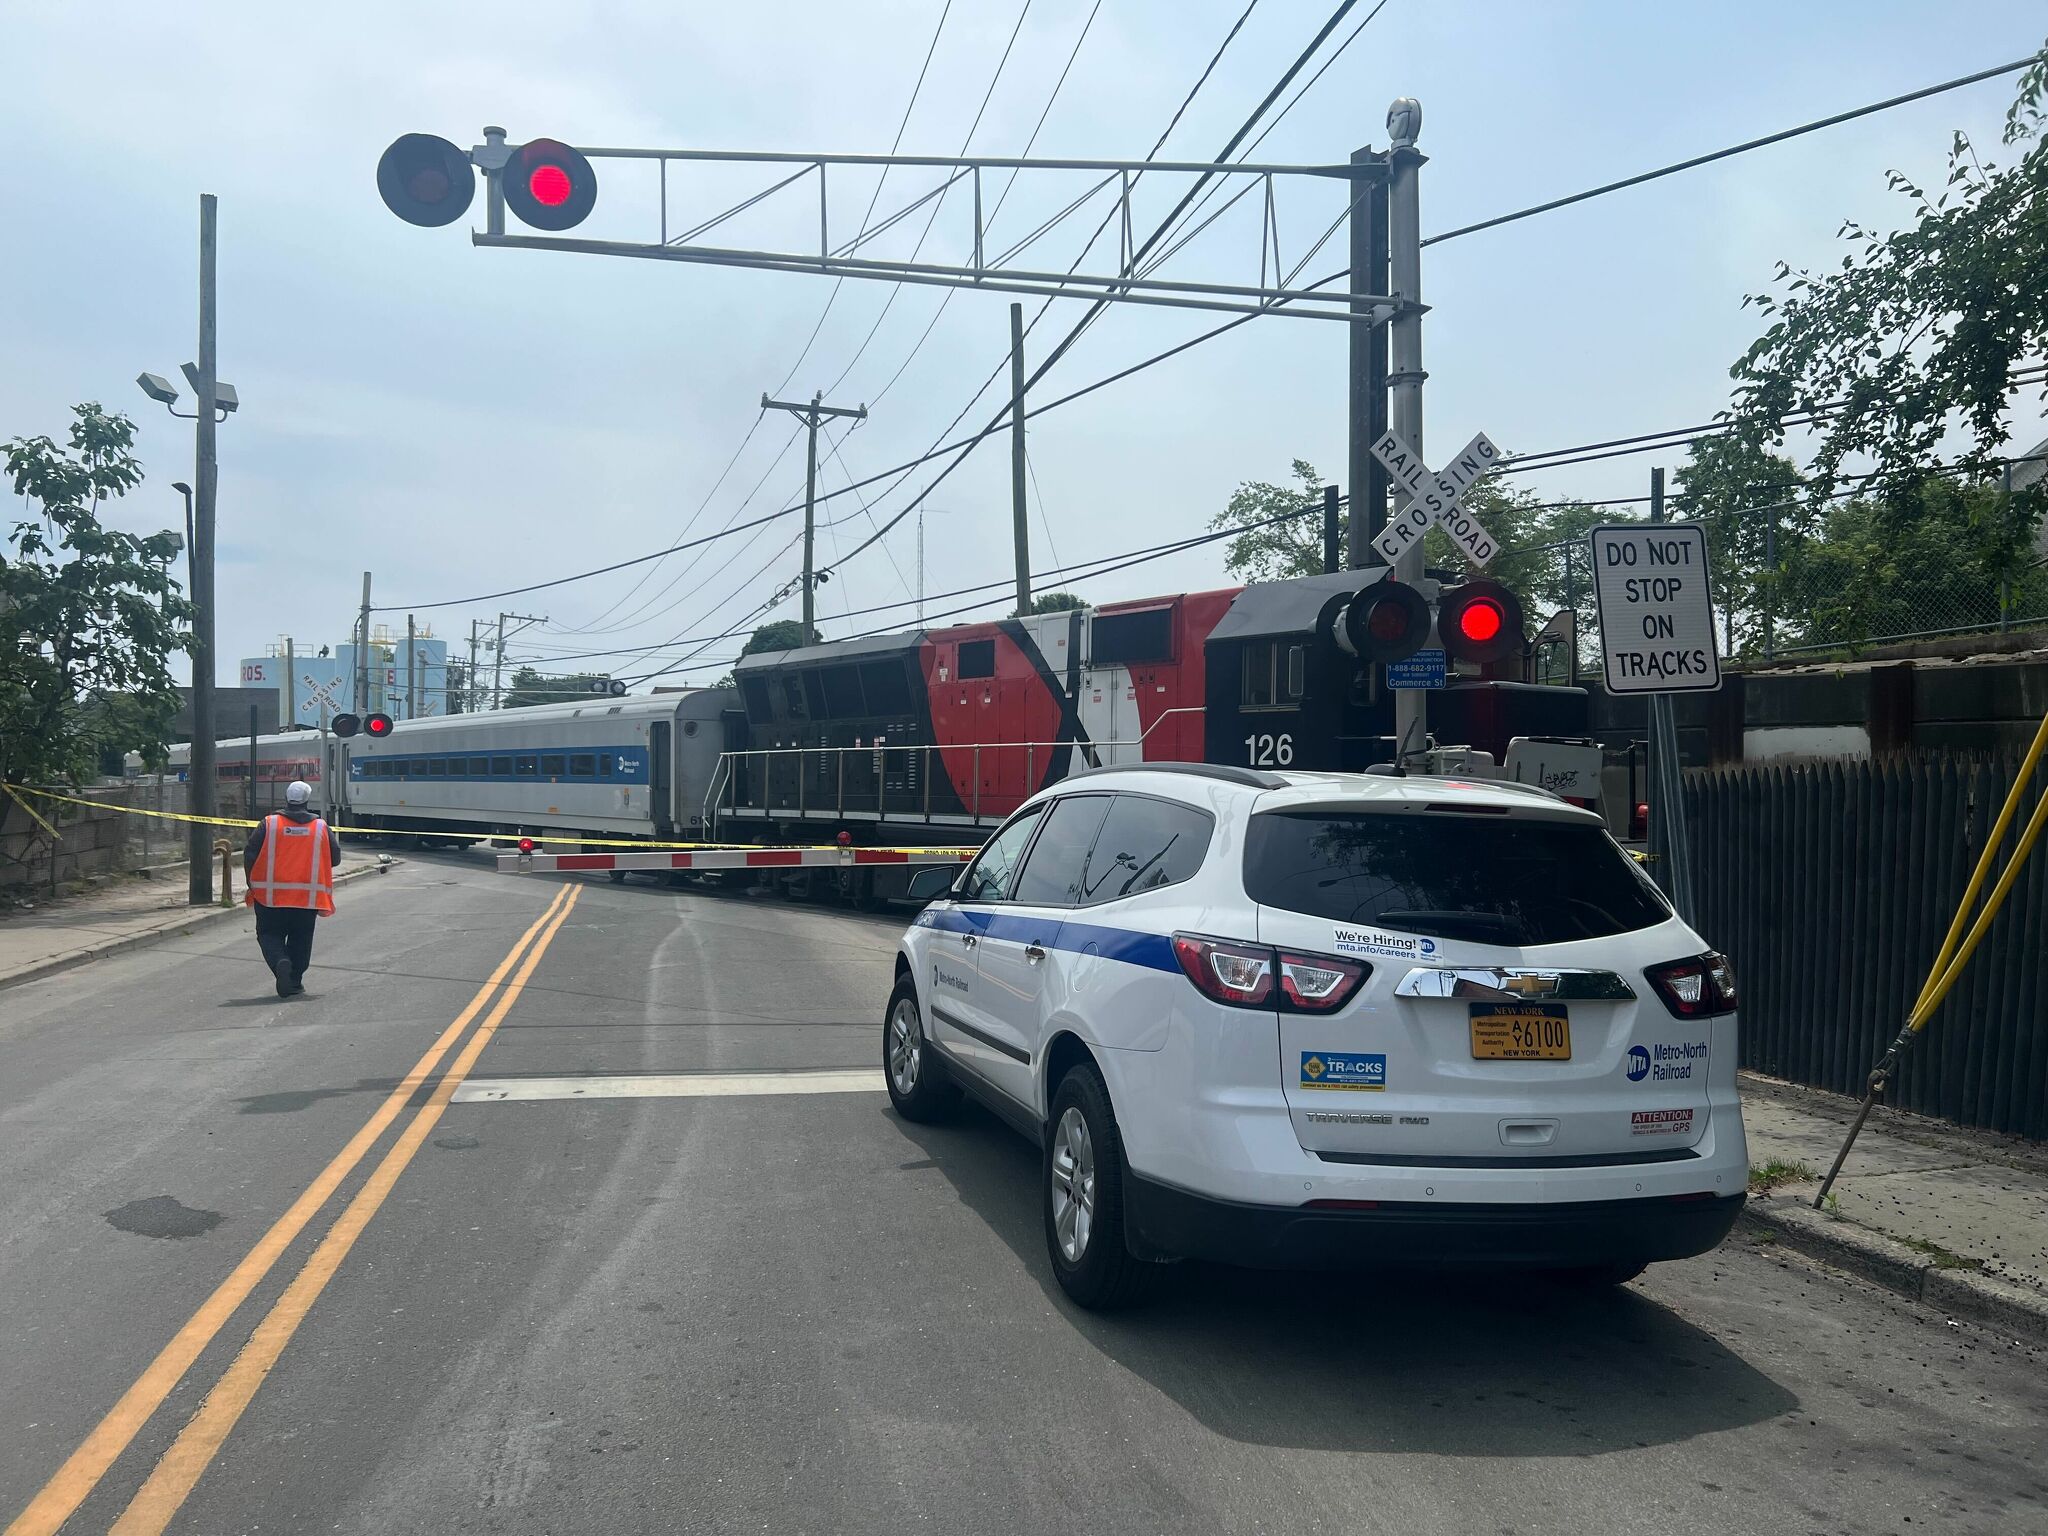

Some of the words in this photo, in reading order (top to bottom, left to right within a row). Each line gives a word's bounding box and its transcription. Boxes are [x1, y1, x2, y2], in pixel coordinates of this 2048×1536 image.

[1378, 437, 1423, 491] RAIL
[1382, 441, 1494, 557] CROSSING
[1443, 507, 1491, 559] ROAD
[1606, 541, 1637, 567] DO
[1649, 541, 1691, 566] NOT
[1625, 577, 1682, 603] STOP
[1642, 614, 1674, 639] ON
[1388, 664, 1444, 672] 1-888-682-9117
[1615, 650, 1707, 677] TRACKS
[303, 675, 319, 692] RAIL
[1389, 679, 1431, 687] Commerce
[1434, 679, 1443, 687] St
[302, 676, 343, 711] CROSSING
[324, 696, 341, 713] ROAD
[1244, 733, 1293, 766] 126
[1335, 930, 1371, 943] We're
[1373, 934, 1417, 950] Hiring!
[1337, 943, 1416, 959] mta.info/careers
[1494, 1006, 1516, 1015] NEW
[1520, 1007, 1545, 1016] YORK
[1654, 1041, 1707, 1060] Metro-North
[1327, 1061, 1383, 1074] TRACKS
[1627, 1054, 1647, 1075] MTA
[1653, 1062, 1691, 1081] Railroad
[1306, 1112, 1393, 1125] TRAVERSE
[1633, 1110, 1692, 1123] ATTENTION:
[1672, 1122, 1690, 1132] GPS
